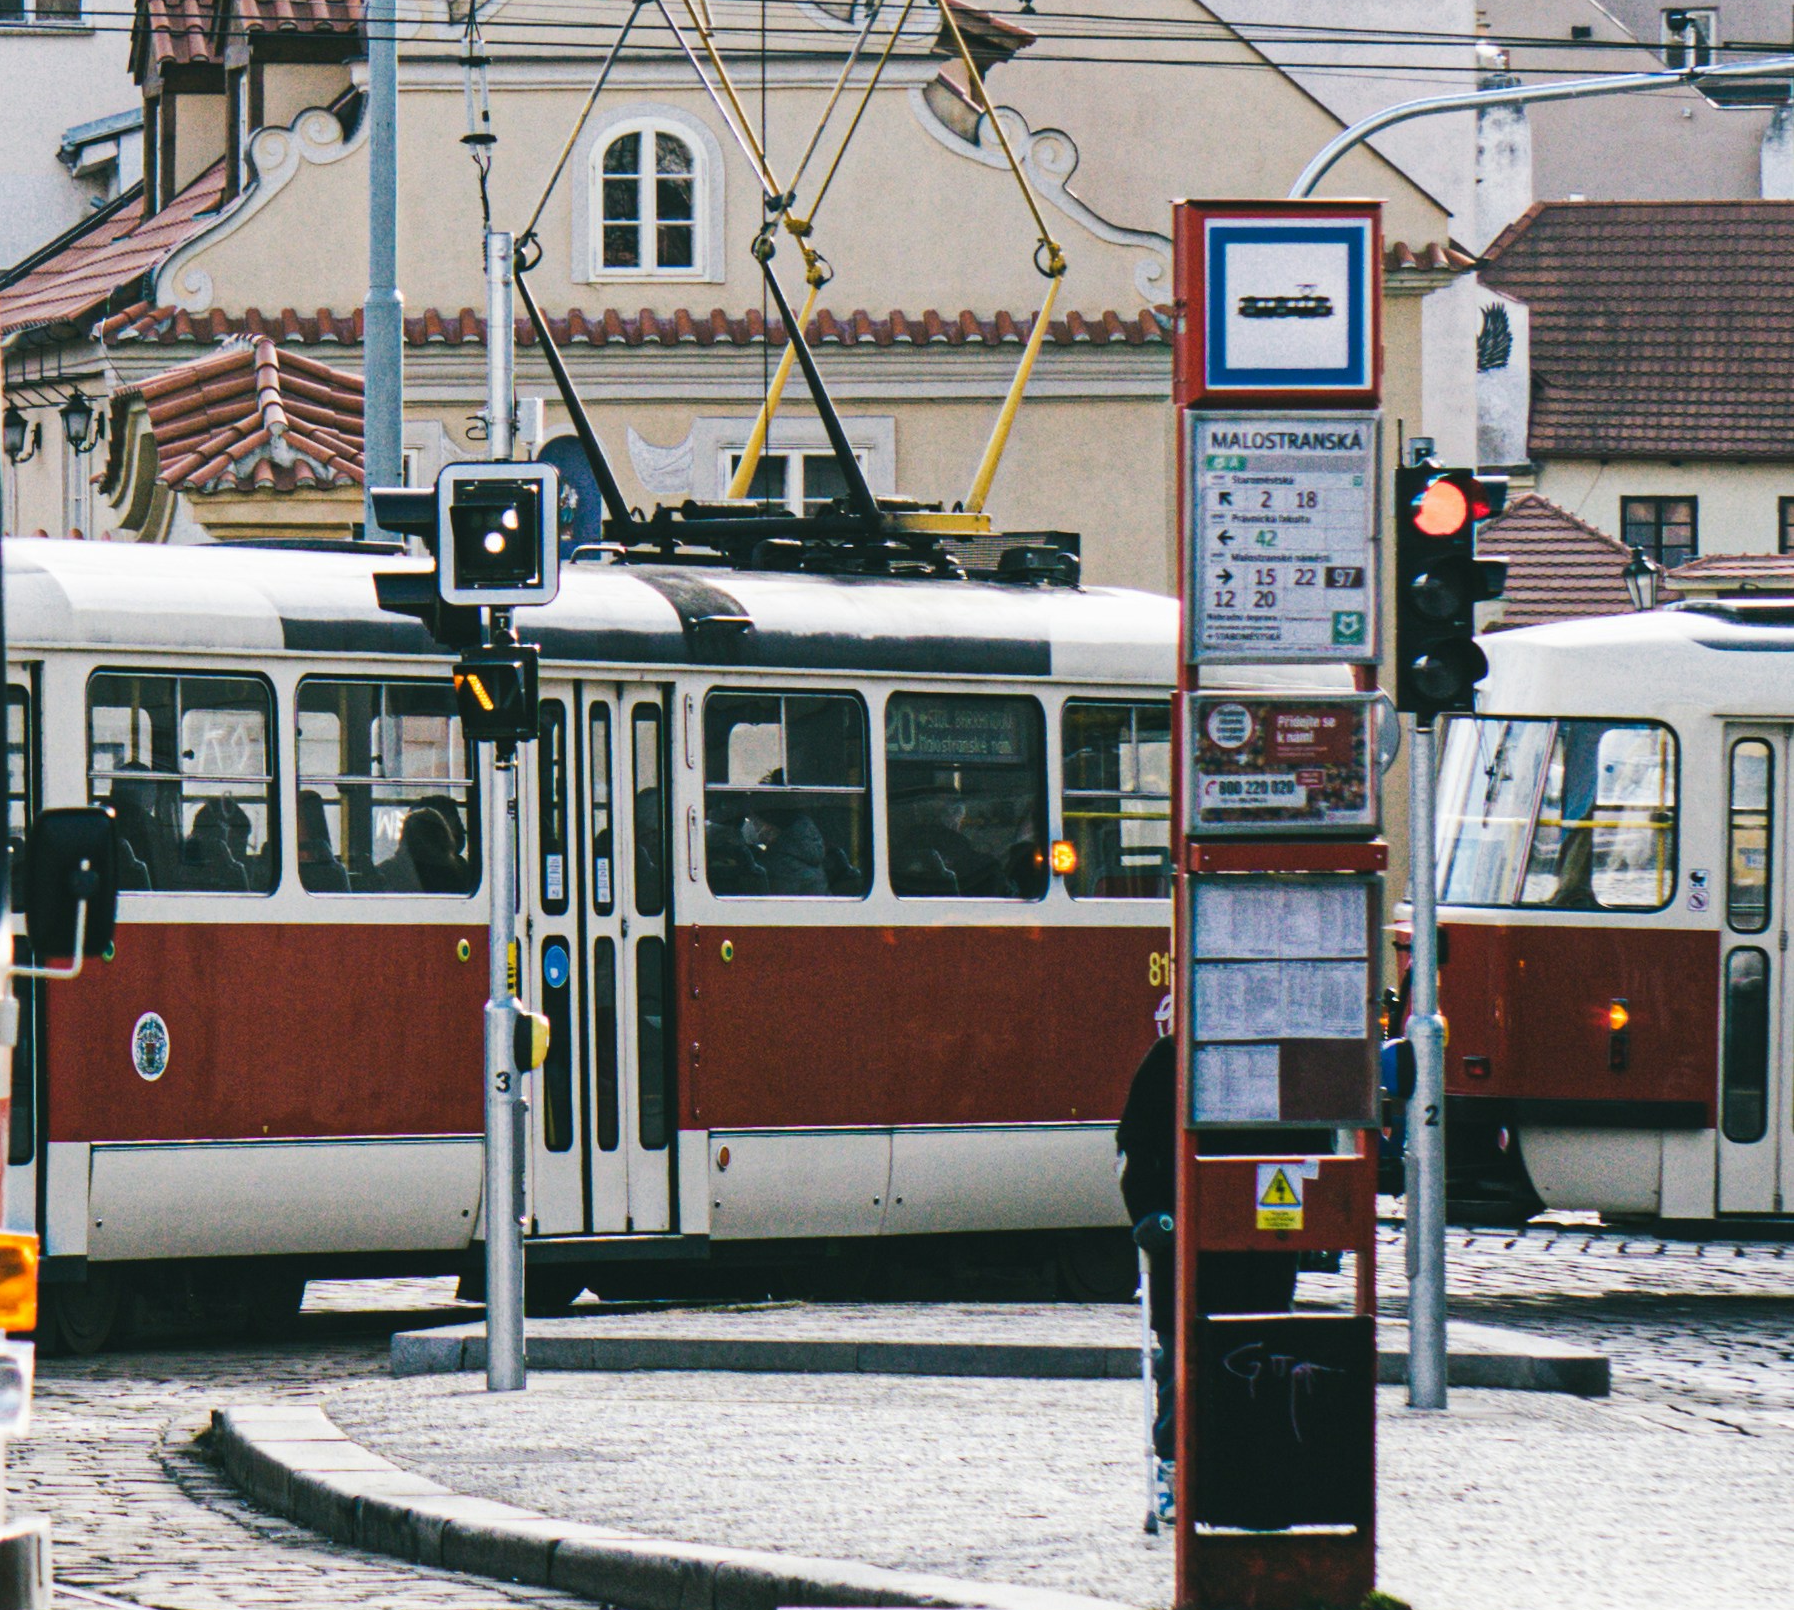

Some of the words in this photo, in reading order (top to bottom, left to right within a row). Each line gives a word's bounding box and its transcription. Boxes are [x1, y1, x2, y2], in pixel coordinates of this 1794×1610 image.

[1211, 429, 1362, 451] MALOSTRANSKÁ
[1260, 490, 1273, 509] 2
[1296, 490, 1318, 509] 18
[1255, 529, 1278, 547] 42
[1255, 568, 1277, 586] 15
[1294, 568, 1316, 586] 22
[1333, 568, 1357, 587] 97
[1214, 590, 1237, 608] 12
[1253, 590, 1277, 608] 20
[495, 1071, 511, 1093] 3
[1425, 1105, 1439, 1126] 2
